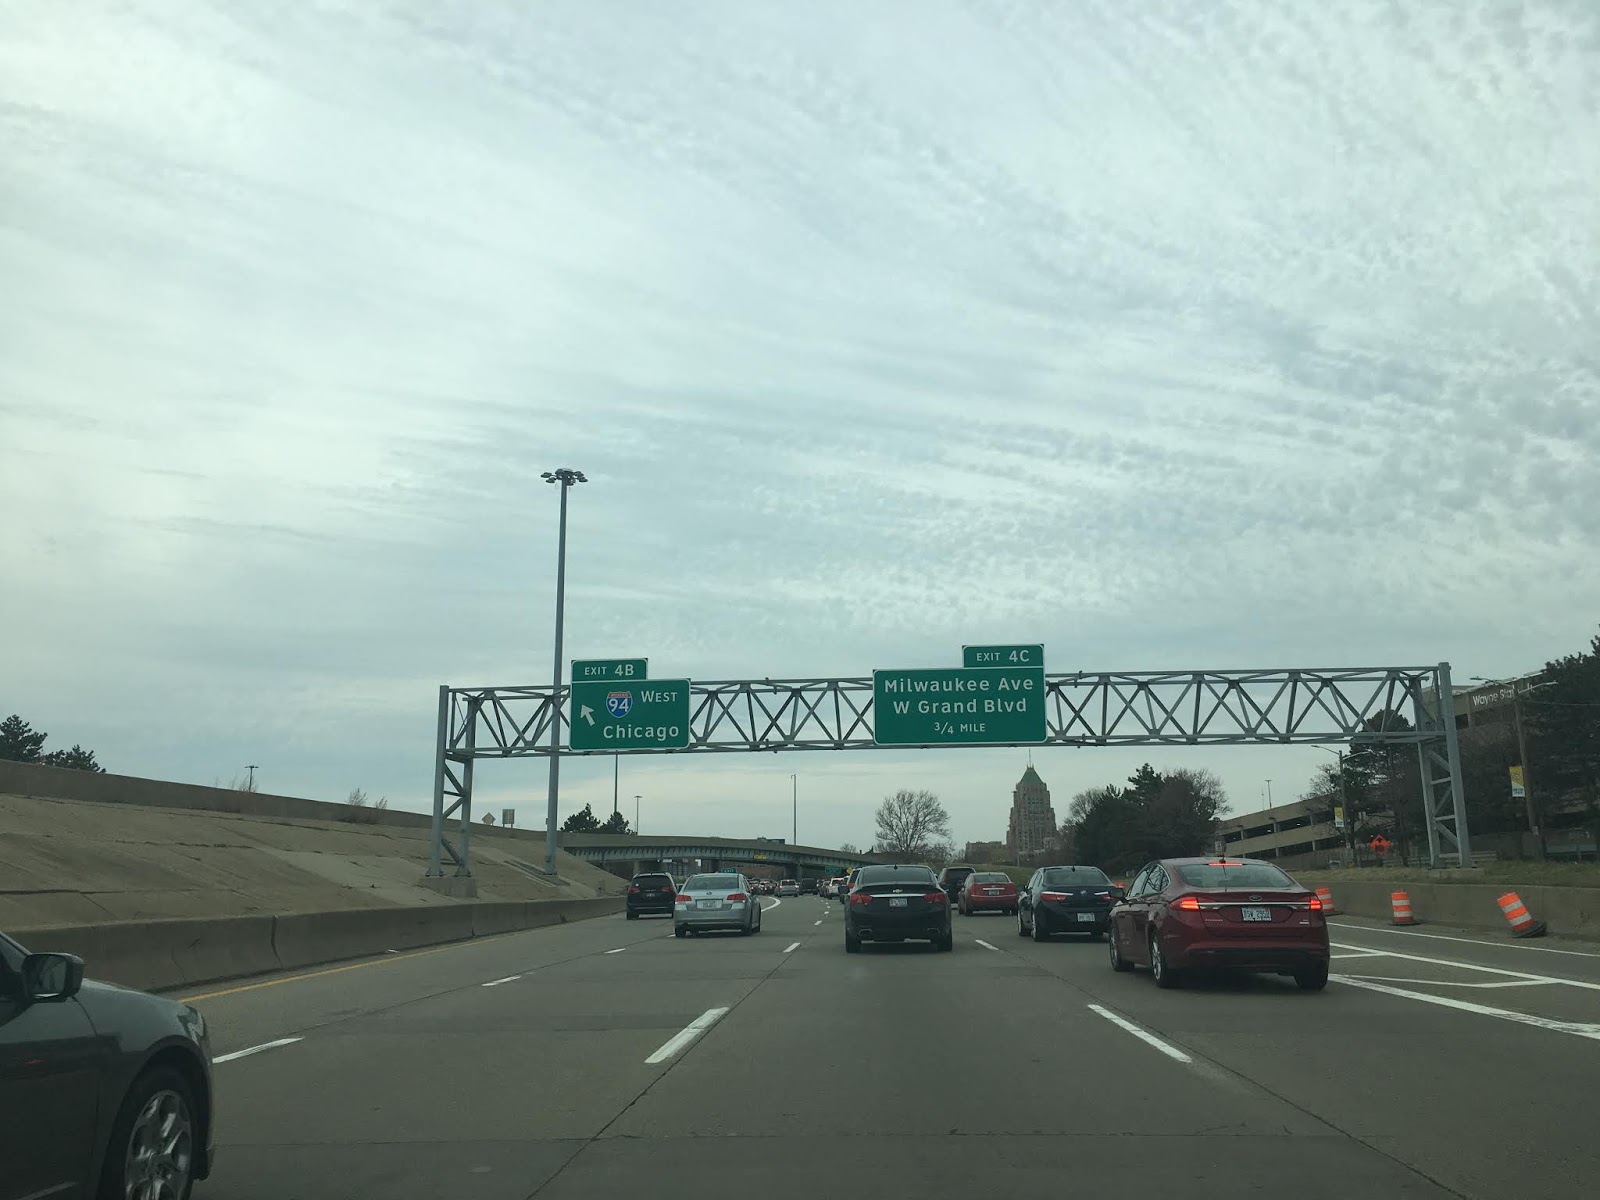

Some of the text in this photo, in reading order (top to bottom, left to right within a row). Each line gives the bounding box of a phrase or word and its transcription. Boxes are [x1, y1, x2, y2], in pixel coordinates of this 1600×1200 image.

[976, 650, 1030, 662] EXIT 4C
[584, 664, 634, 676] EXIT 4B
[884, 678, 1033, 693] Milwaukee Ave
[608, 690, 678, 712] 94 WEST
[893, 698, 1027, 714] W Grand Blvd
[1472, 692, 1498, 706] Wayne
[603, 724, 679, 741] Chicago
[934, 722, 986, 735] 3/4 MILE
